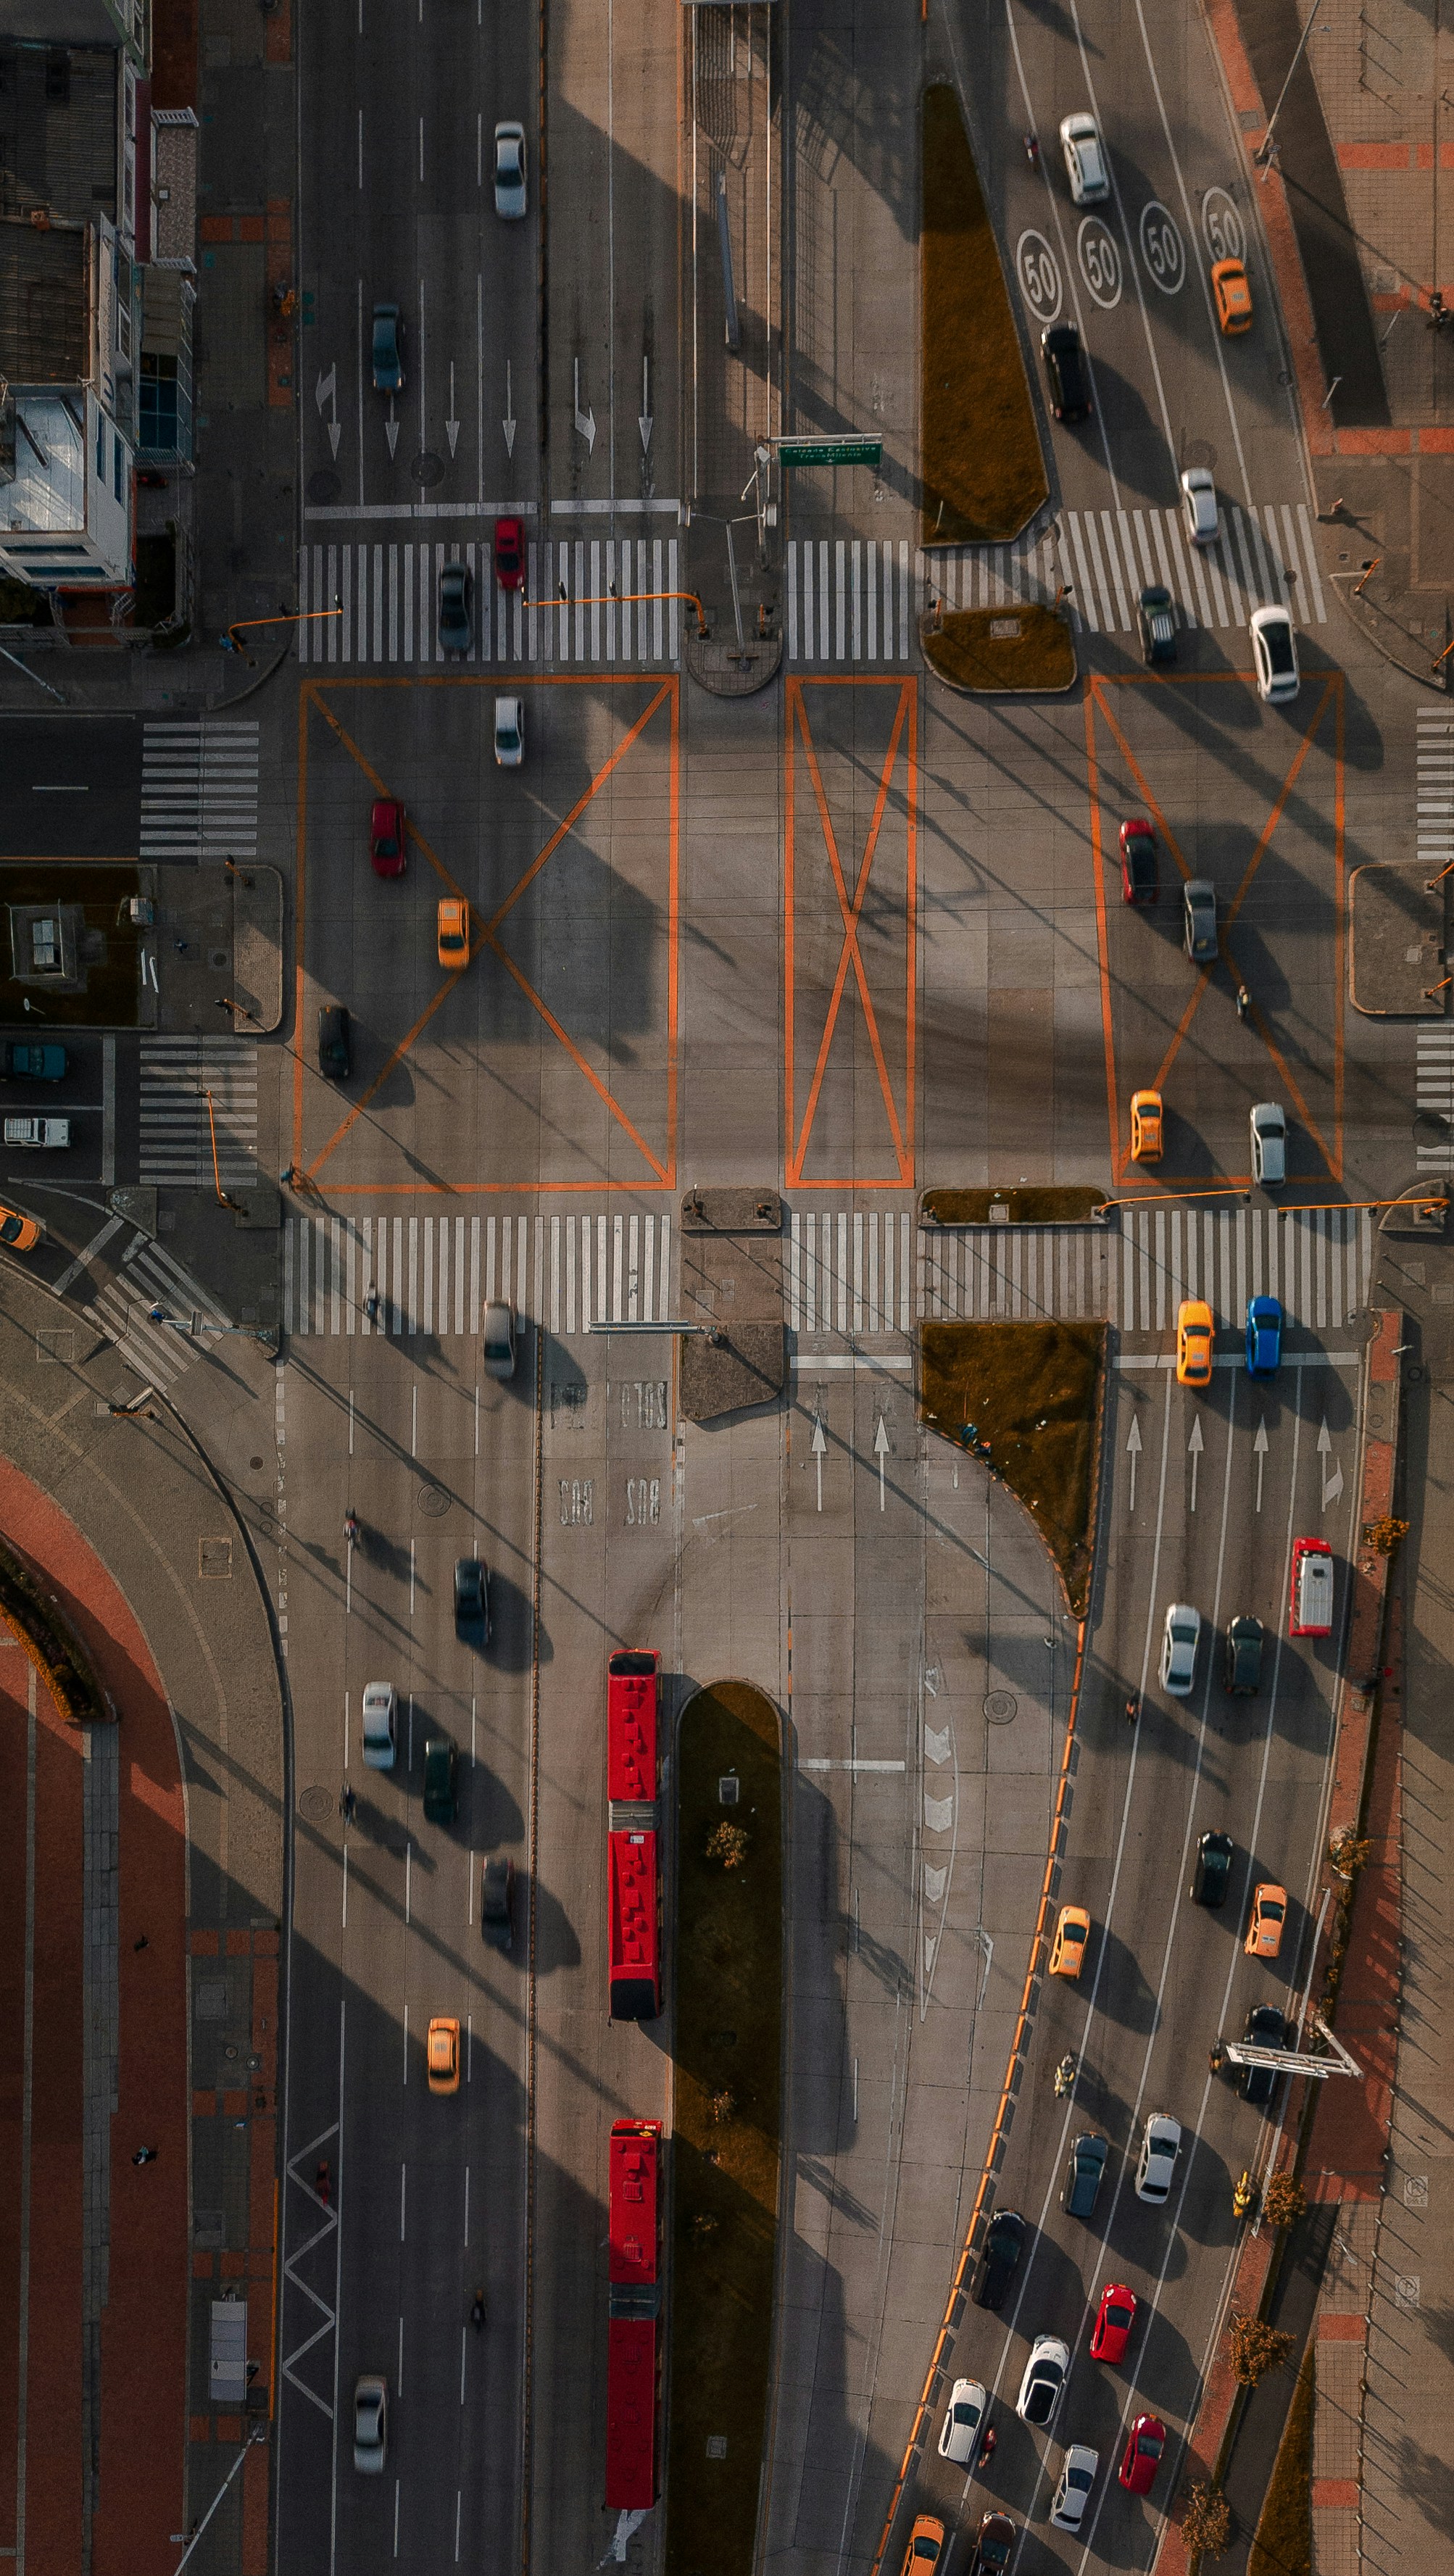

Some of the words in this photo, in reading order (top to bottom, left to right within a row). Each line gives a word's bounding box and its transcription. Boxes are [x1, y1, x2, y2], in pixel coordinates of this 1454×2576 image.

[1147, 224, 1178, 275] 50
[1209, 211, 1239, 258] 50
[1024, 254, 1055, 304] 50
[1085, 238, 1116, 289] 50
[627, 1479, 660, 1526] BUS
